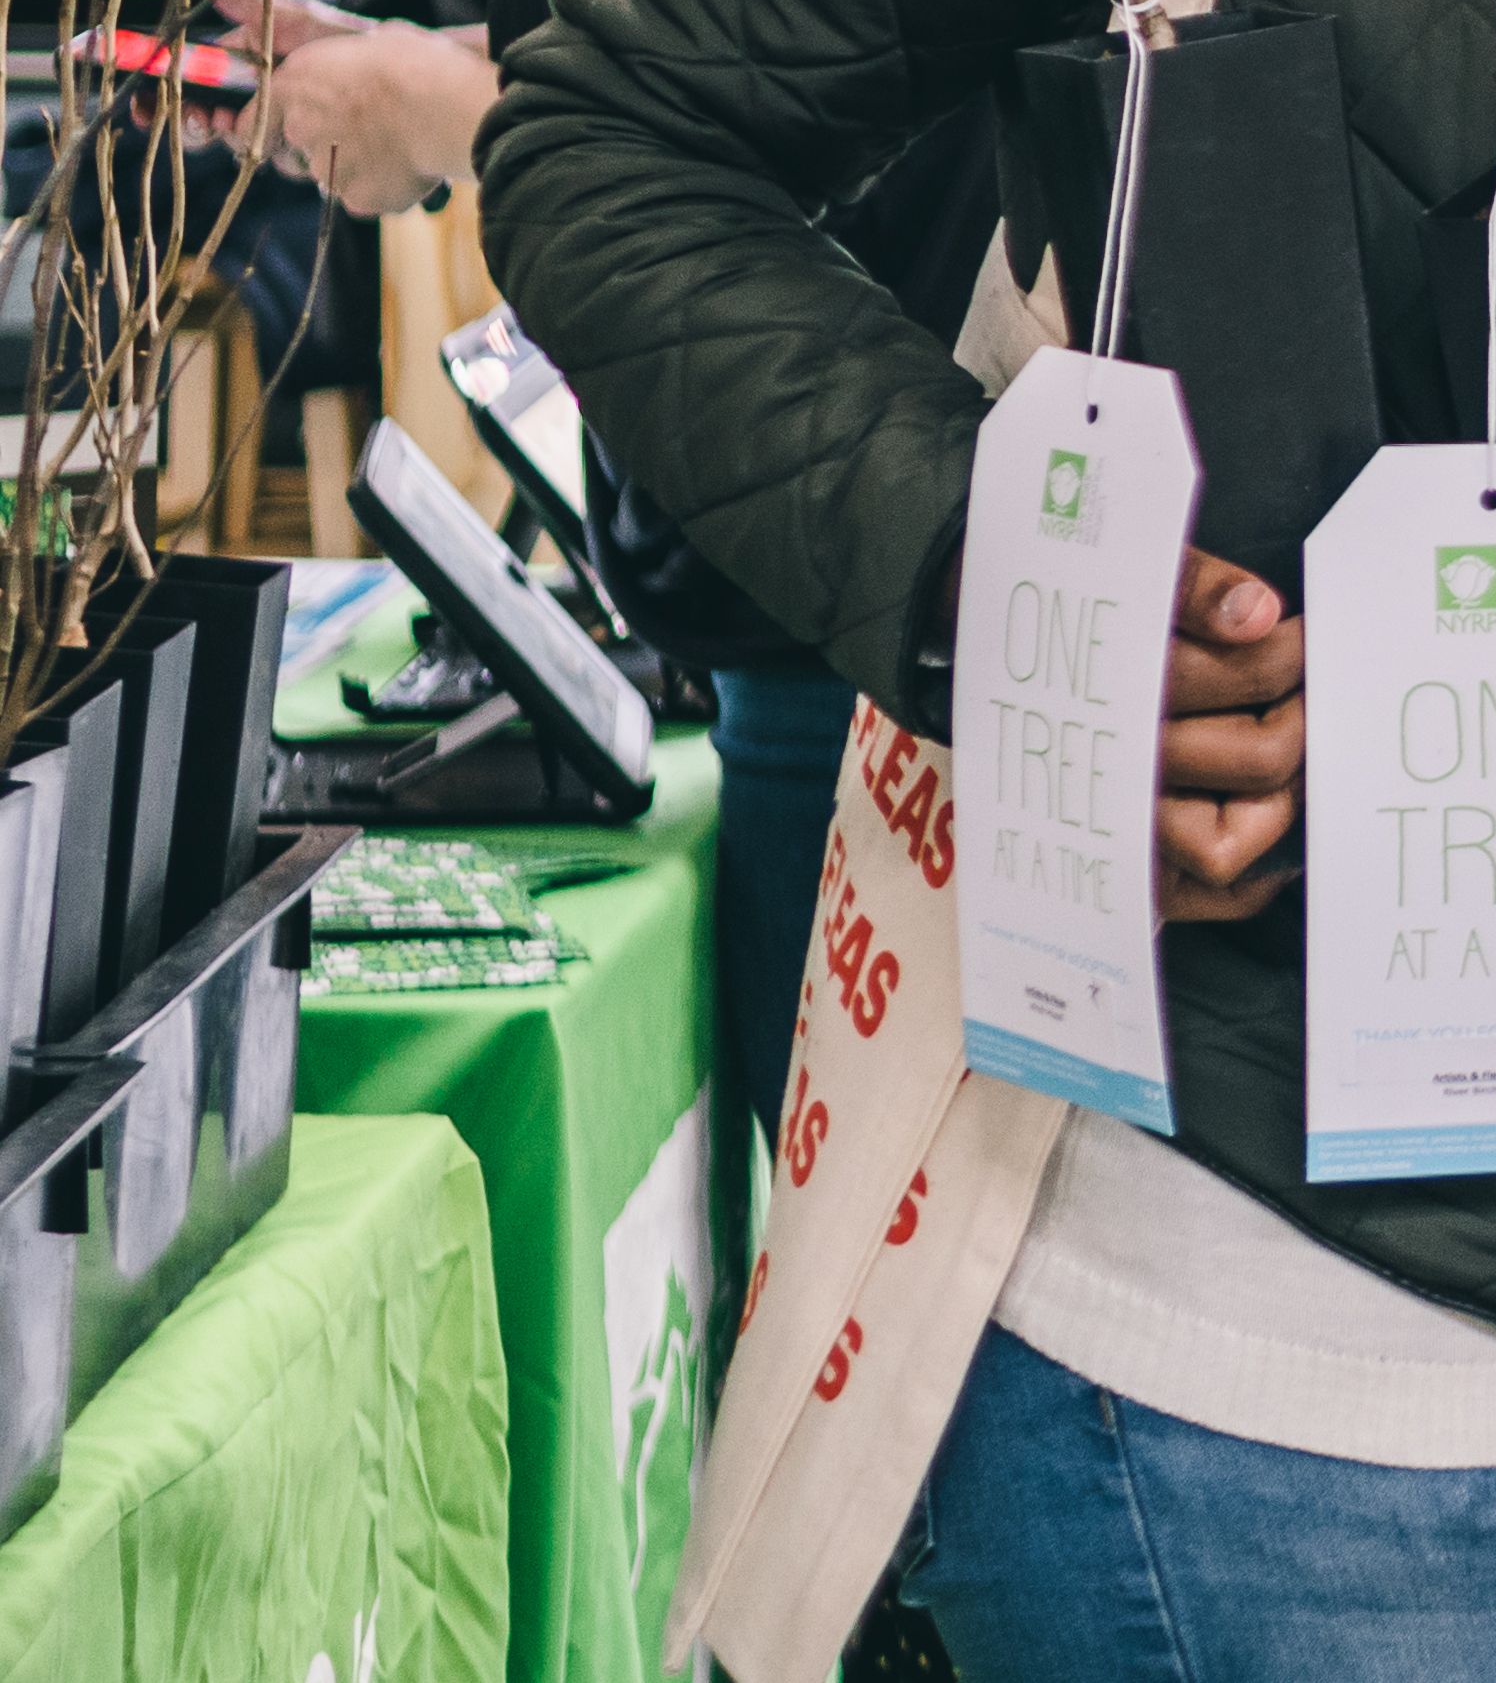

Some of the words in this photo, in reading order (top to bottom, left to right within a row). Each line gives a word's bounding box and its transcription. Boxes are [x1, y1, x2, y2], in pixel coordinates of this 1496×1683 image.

[1003, 579, 1120, 706] ONE
[988, 698, 1118, 838] TREE
[993, 828, 1024, 884] AT
[1031, 840, 1050, 891] A
[1056, 846, 1114, 916] TIME
[1385, 927, 1437, 981] AT
[1460, 928, 1490, 979] A
